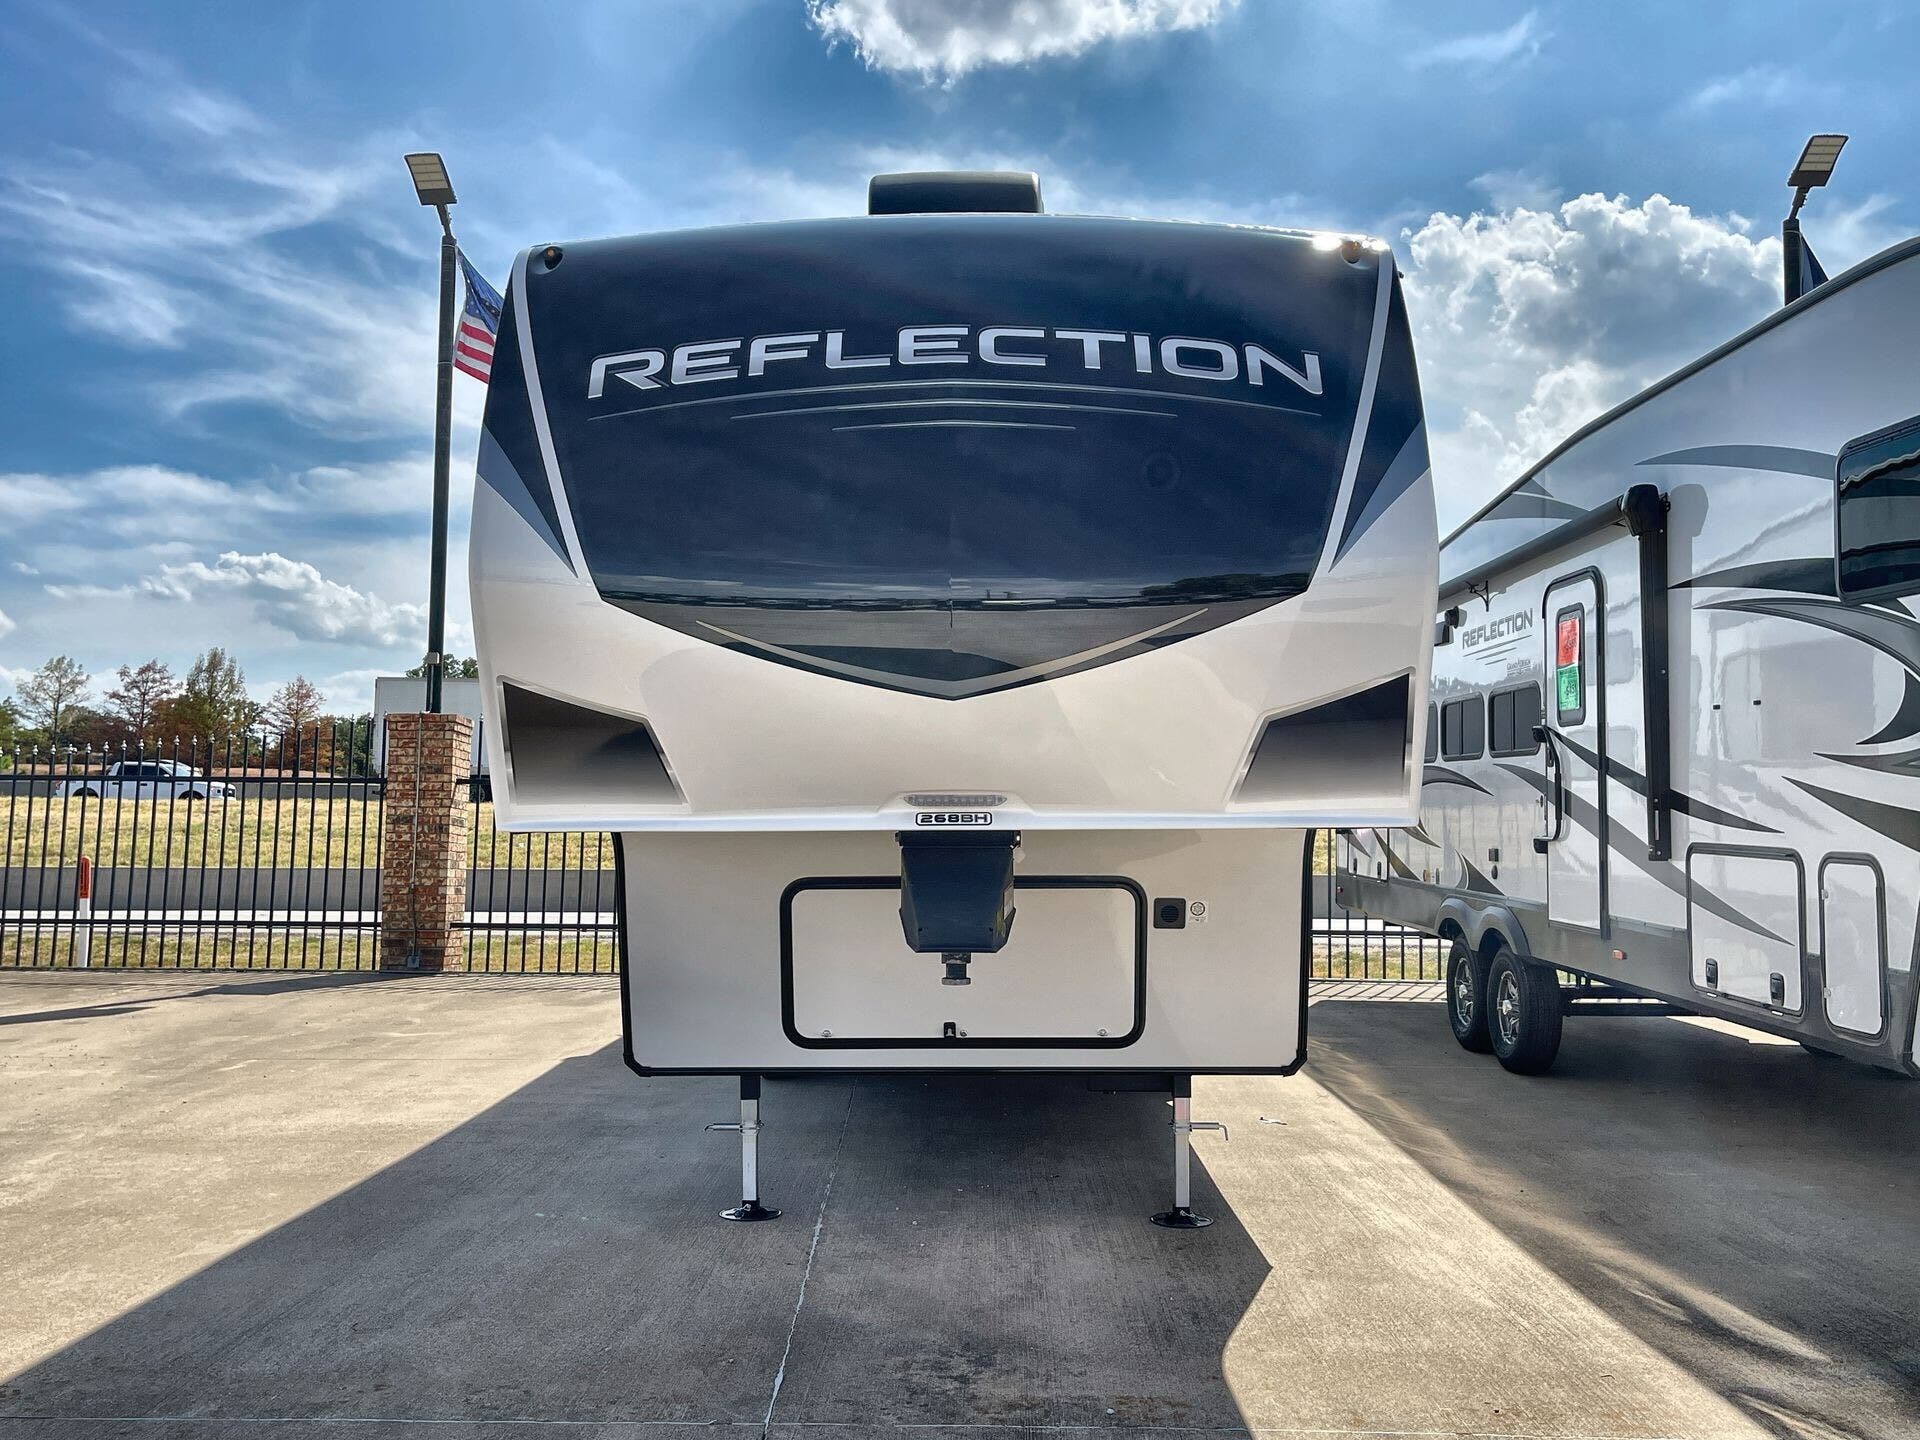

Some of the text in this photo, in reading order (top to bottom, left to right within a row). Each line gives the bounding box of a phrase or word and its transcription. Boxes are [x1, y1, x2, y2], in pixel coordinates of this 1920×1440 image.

[588, 325, 1324, 399] REFLECTION
[1462, 608, 1533, 650] REFLECTION
[920, 814, 989, 824] 268BH
